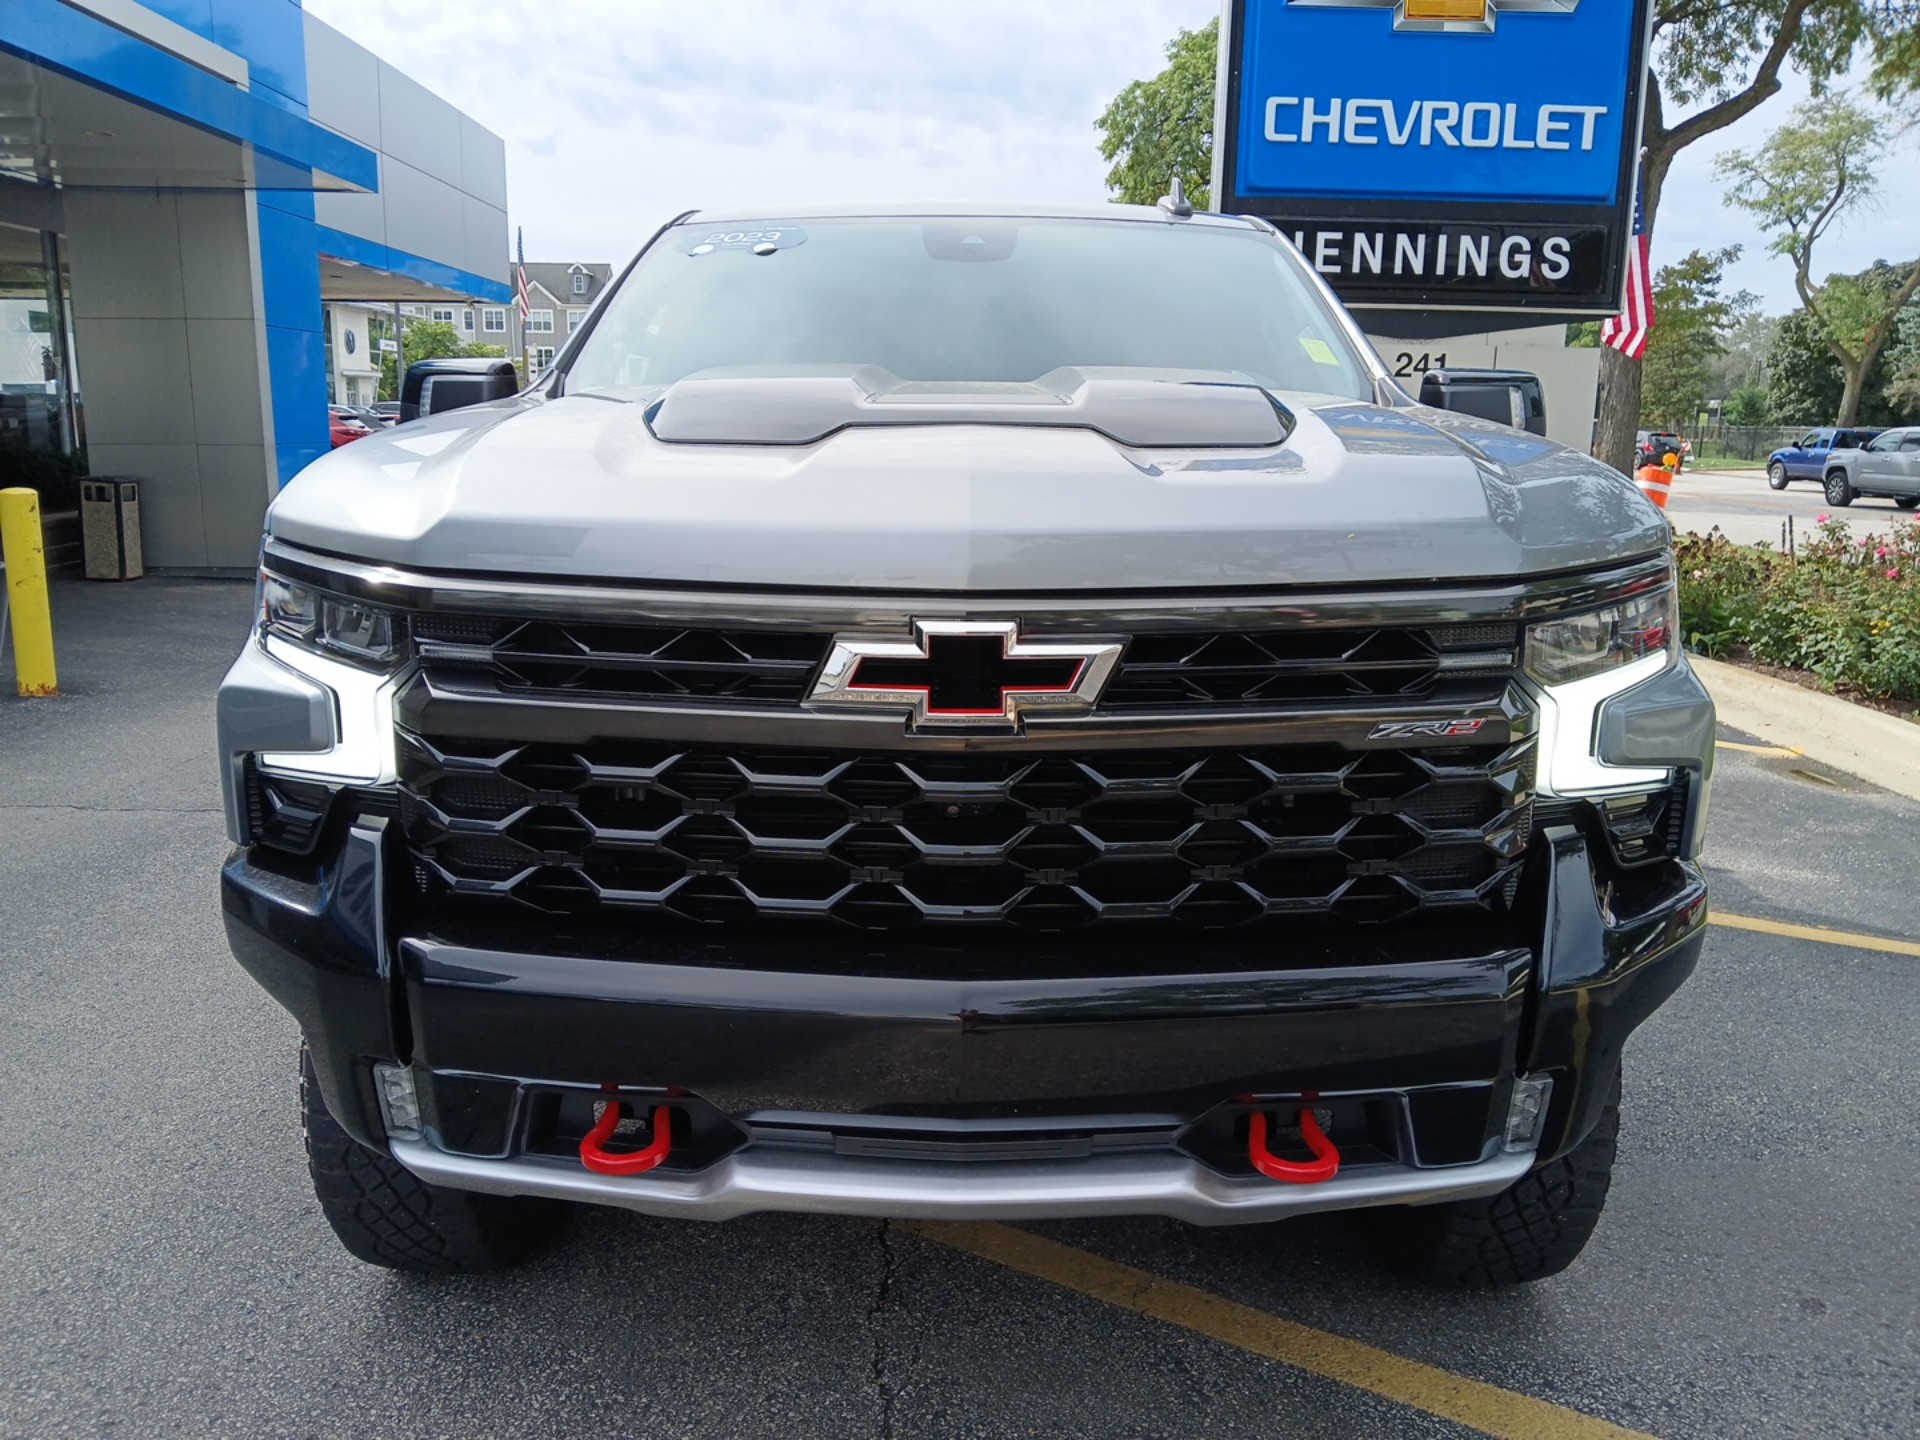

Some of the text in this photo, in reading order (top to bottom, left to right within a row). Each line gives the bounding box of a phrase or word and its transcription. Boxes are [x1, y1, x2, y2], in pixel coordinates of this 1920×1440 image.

[1264, 96, 1608, 150] CHEVROLET
[703, 231, 781, 243] 2023
[1394, 352, 1446, 378] 241
[1366, 717, 1488, 741] ZR2
